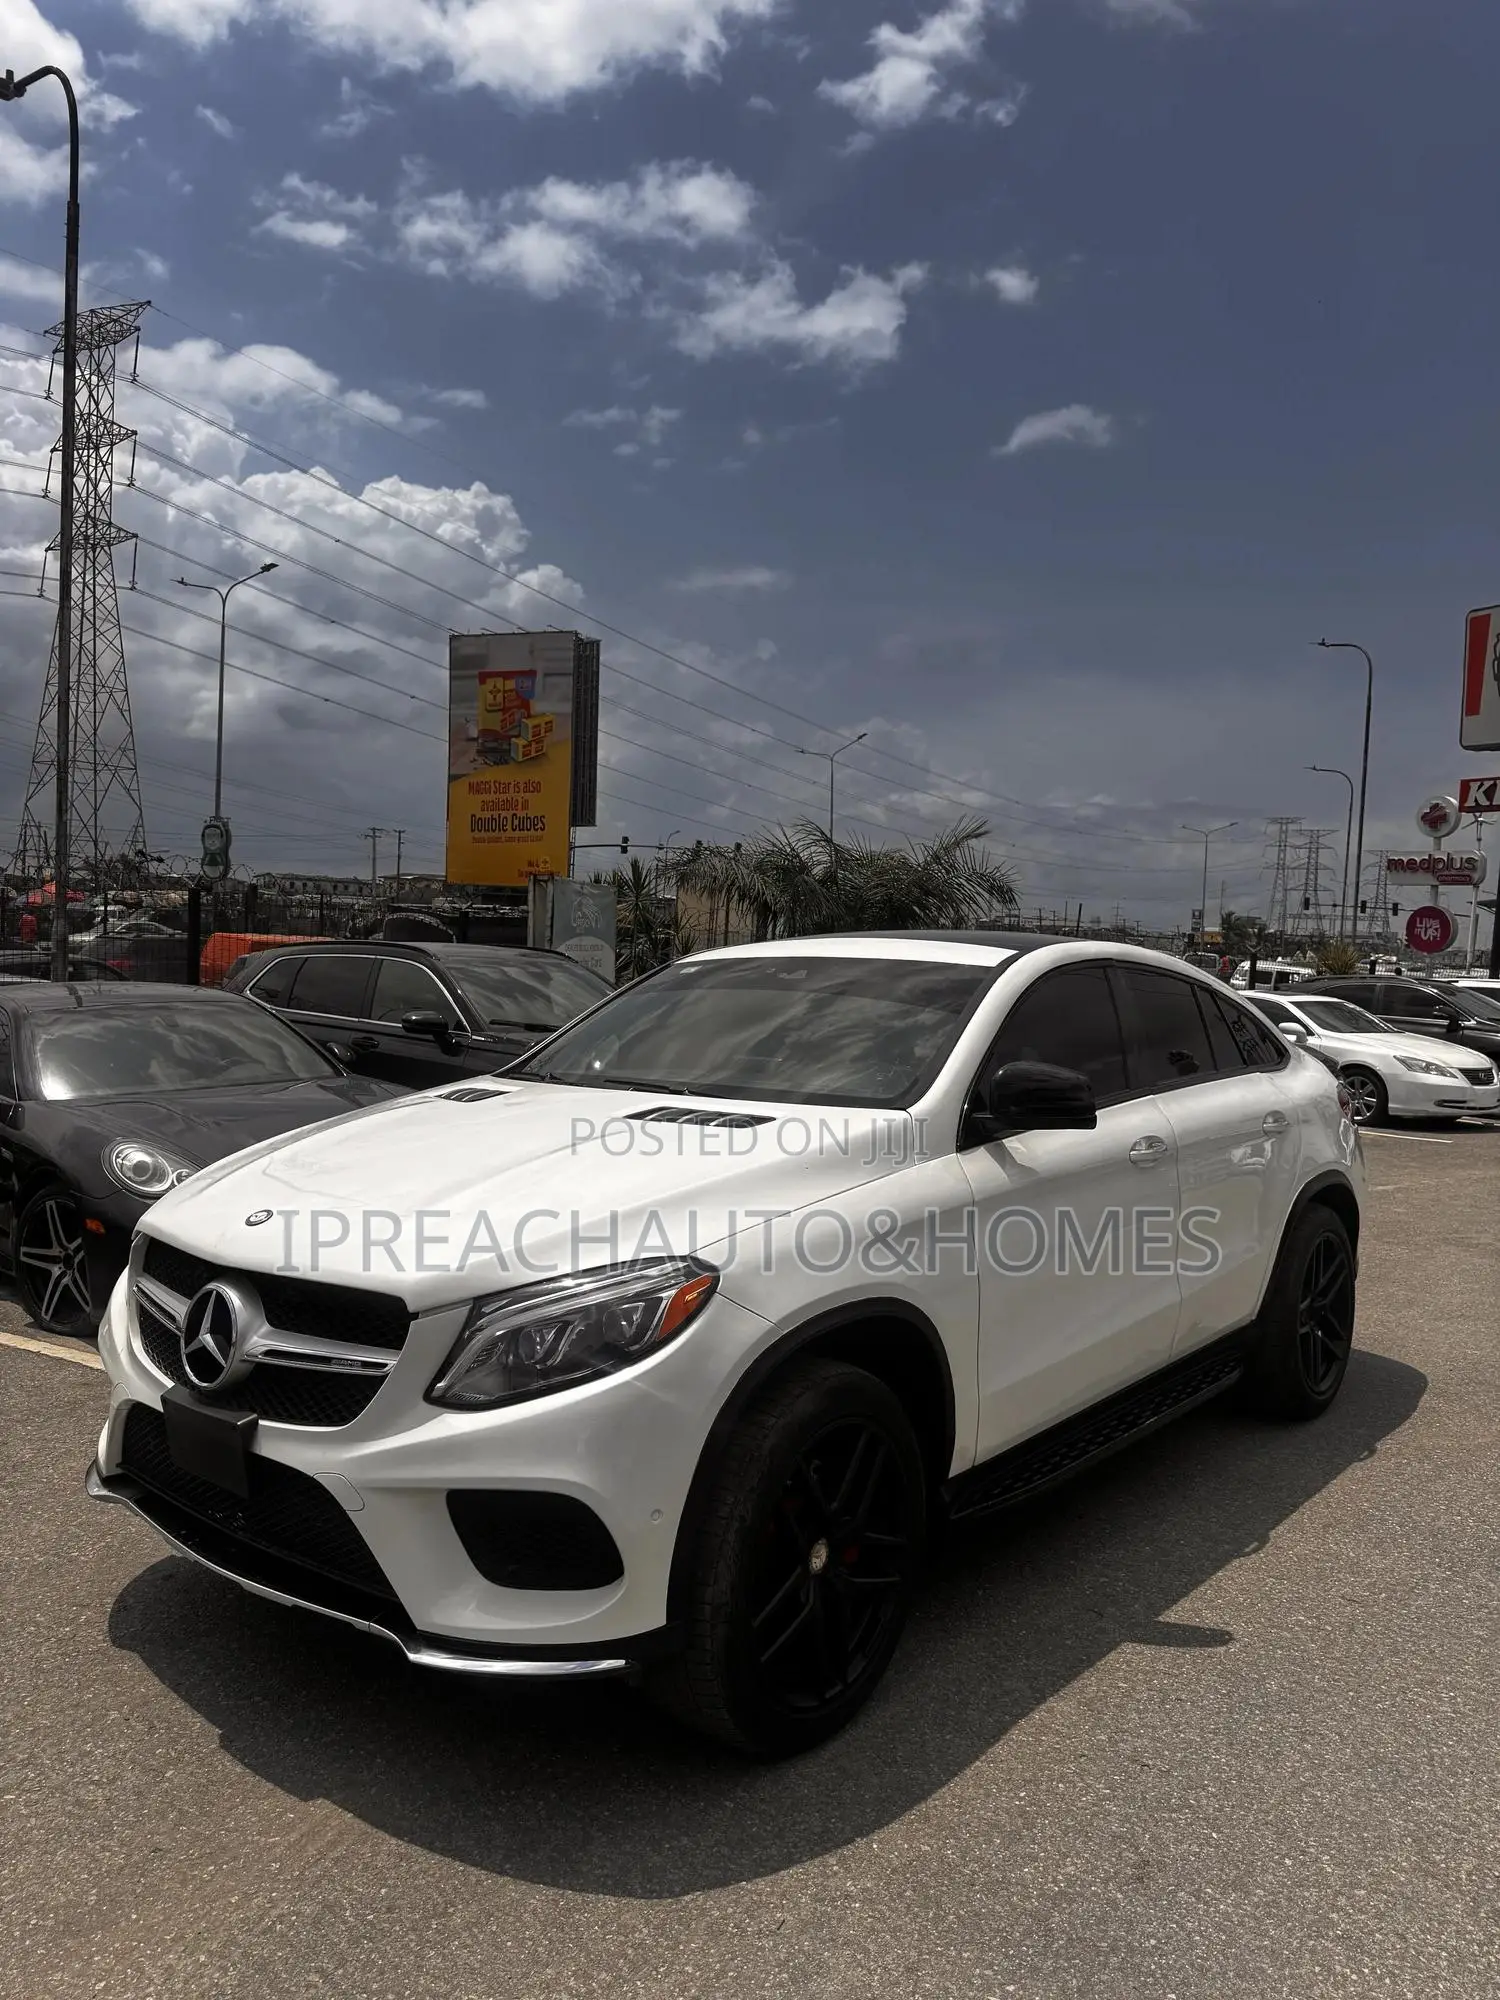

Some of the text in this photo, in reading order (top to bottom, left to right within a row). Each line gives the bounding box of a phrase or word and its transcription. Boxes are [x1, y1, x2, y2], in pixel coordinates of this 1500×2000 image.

[493, 780, 511, 795] Star
[513, 779, 521, 794] is
[523, 778, 542, 794] also
[480, 796, 529, 812] available in
[470, 813, 546, 833] Double Cubes
[1387, 852, 1478, 875] medplus
[1416, 917, 1440, 928] LIVE
[1421, 927, 1441, 941] UP!
